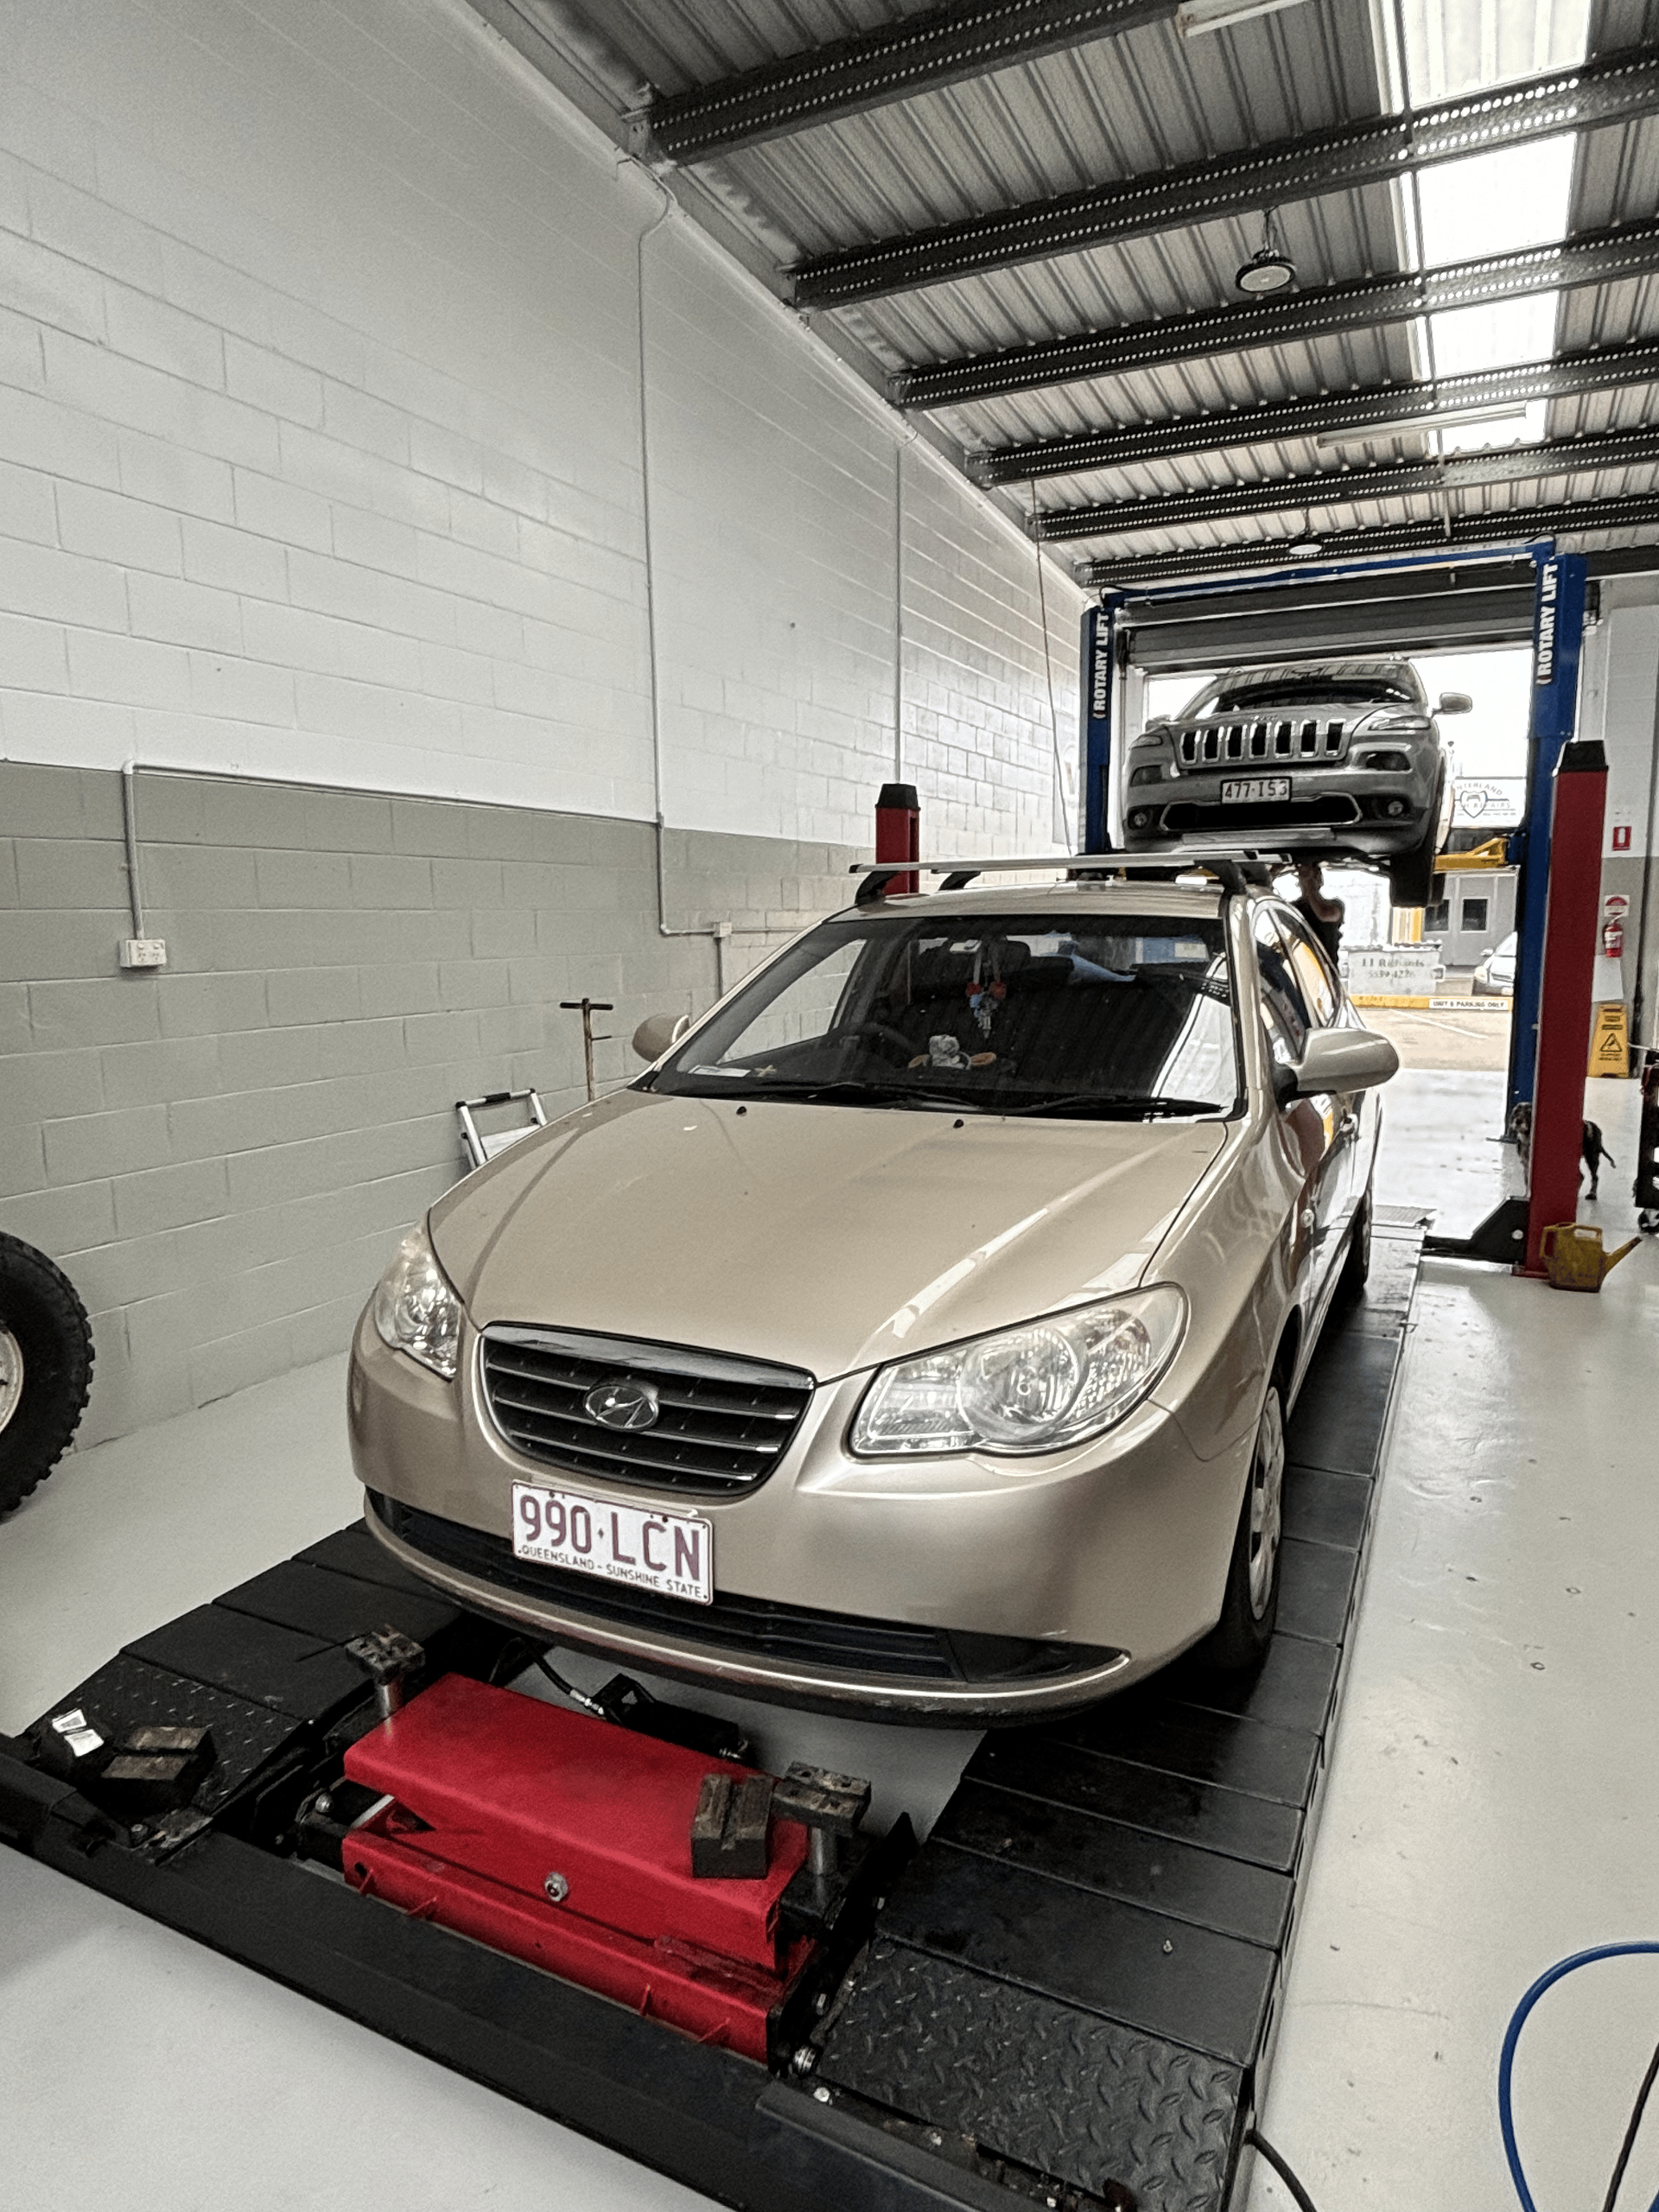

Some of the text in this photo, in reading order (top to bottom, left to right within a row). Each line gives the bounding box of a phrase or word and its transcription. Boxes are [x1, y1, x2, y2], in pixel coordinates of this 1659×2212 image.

[1537, 563, 1558, 677] ROTARY LIFT
[1093, 613, 1109, 711] ROTARY LIFT
[1456, 782, 1503, 796] NTERLAND
[521, 1544, 594, 1571] QUEENSLAND
[606, 1564, 660, 1588] SUNSHINE
[666, 1578, 702, 1599] STATE
